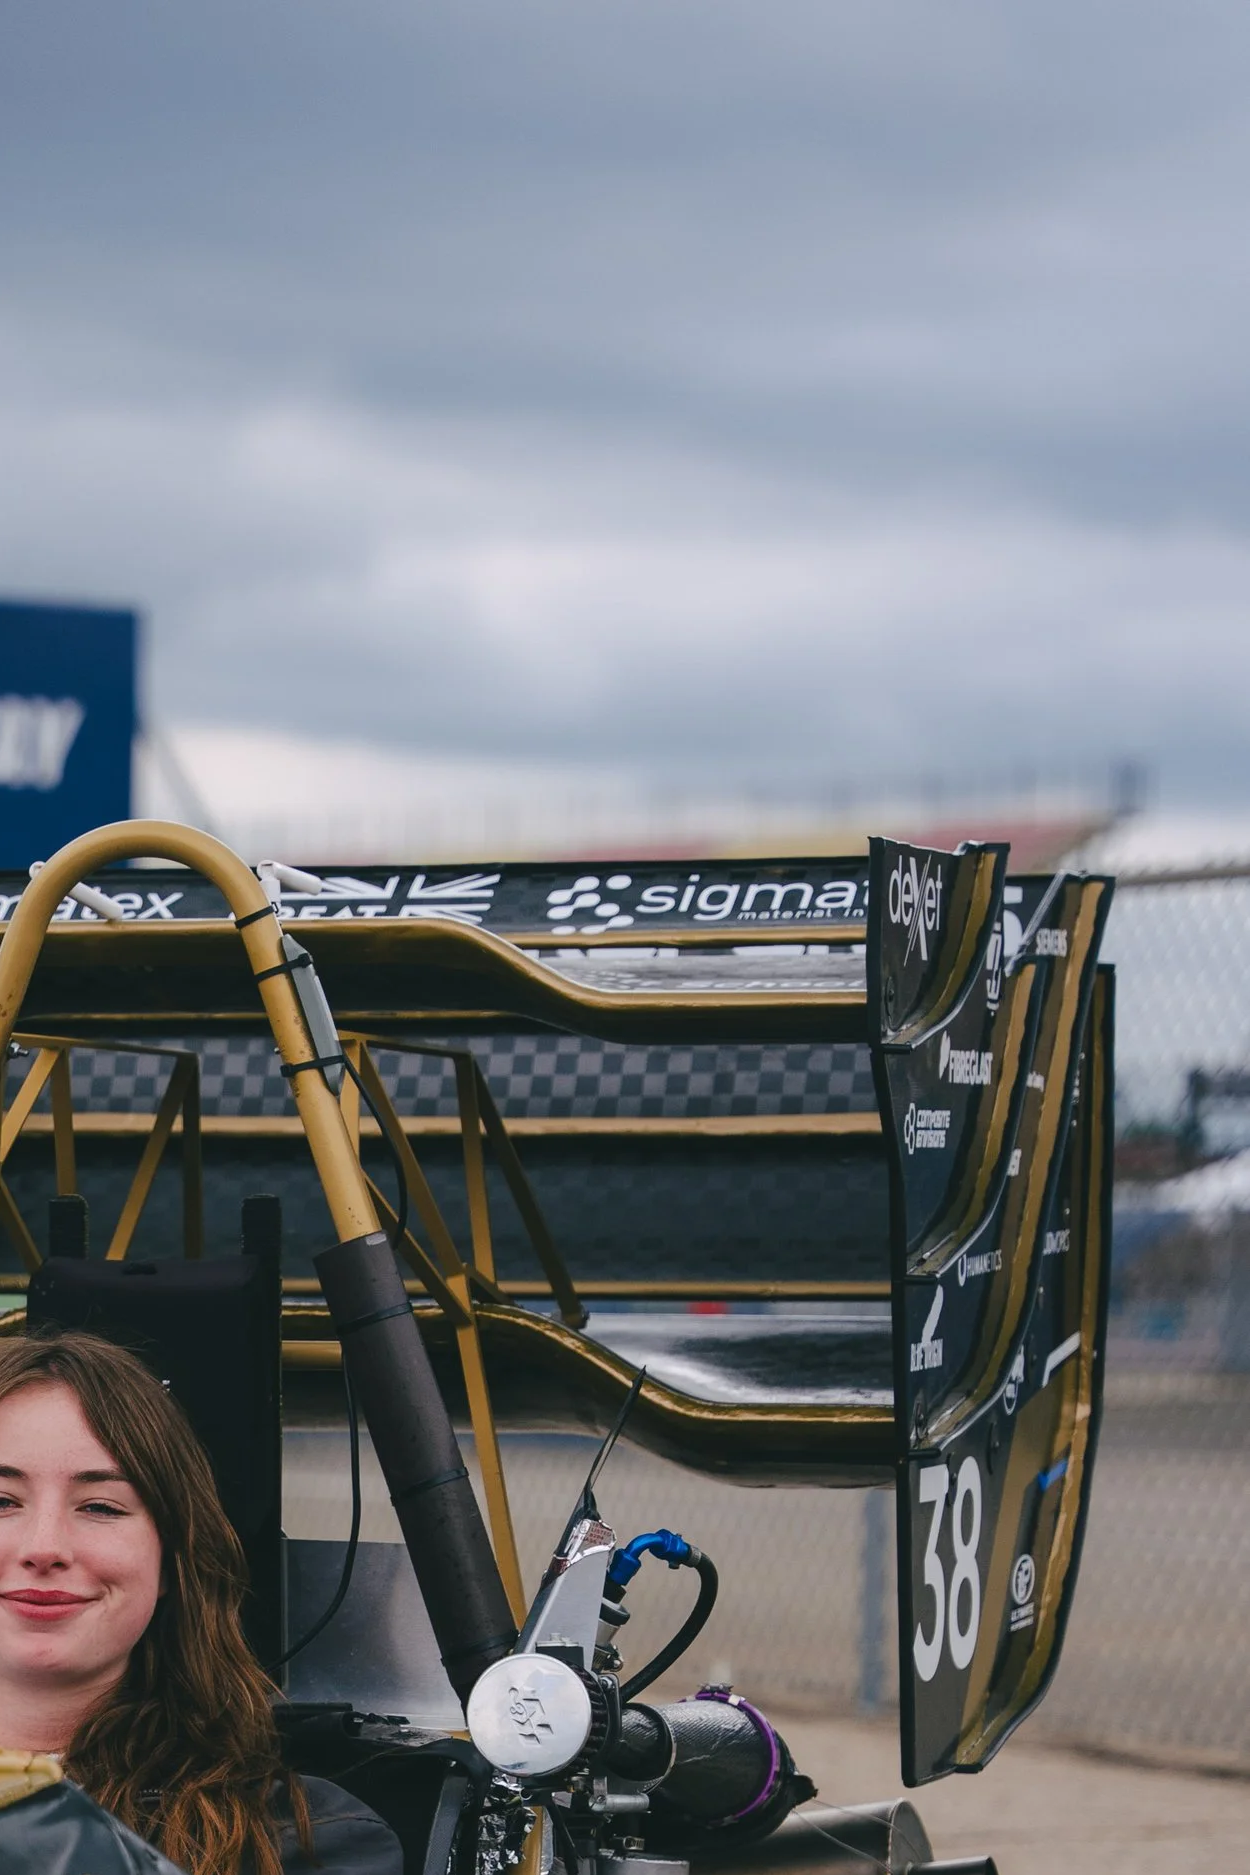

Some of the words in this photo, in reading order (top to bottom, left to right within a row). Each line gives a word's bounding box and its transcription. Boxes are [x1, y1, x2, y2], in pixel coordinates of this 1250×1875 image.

[635, 874, 869, 920] sigma
[736, 907, 832, 921] material
[913, 1455, 982, 1682] 38
